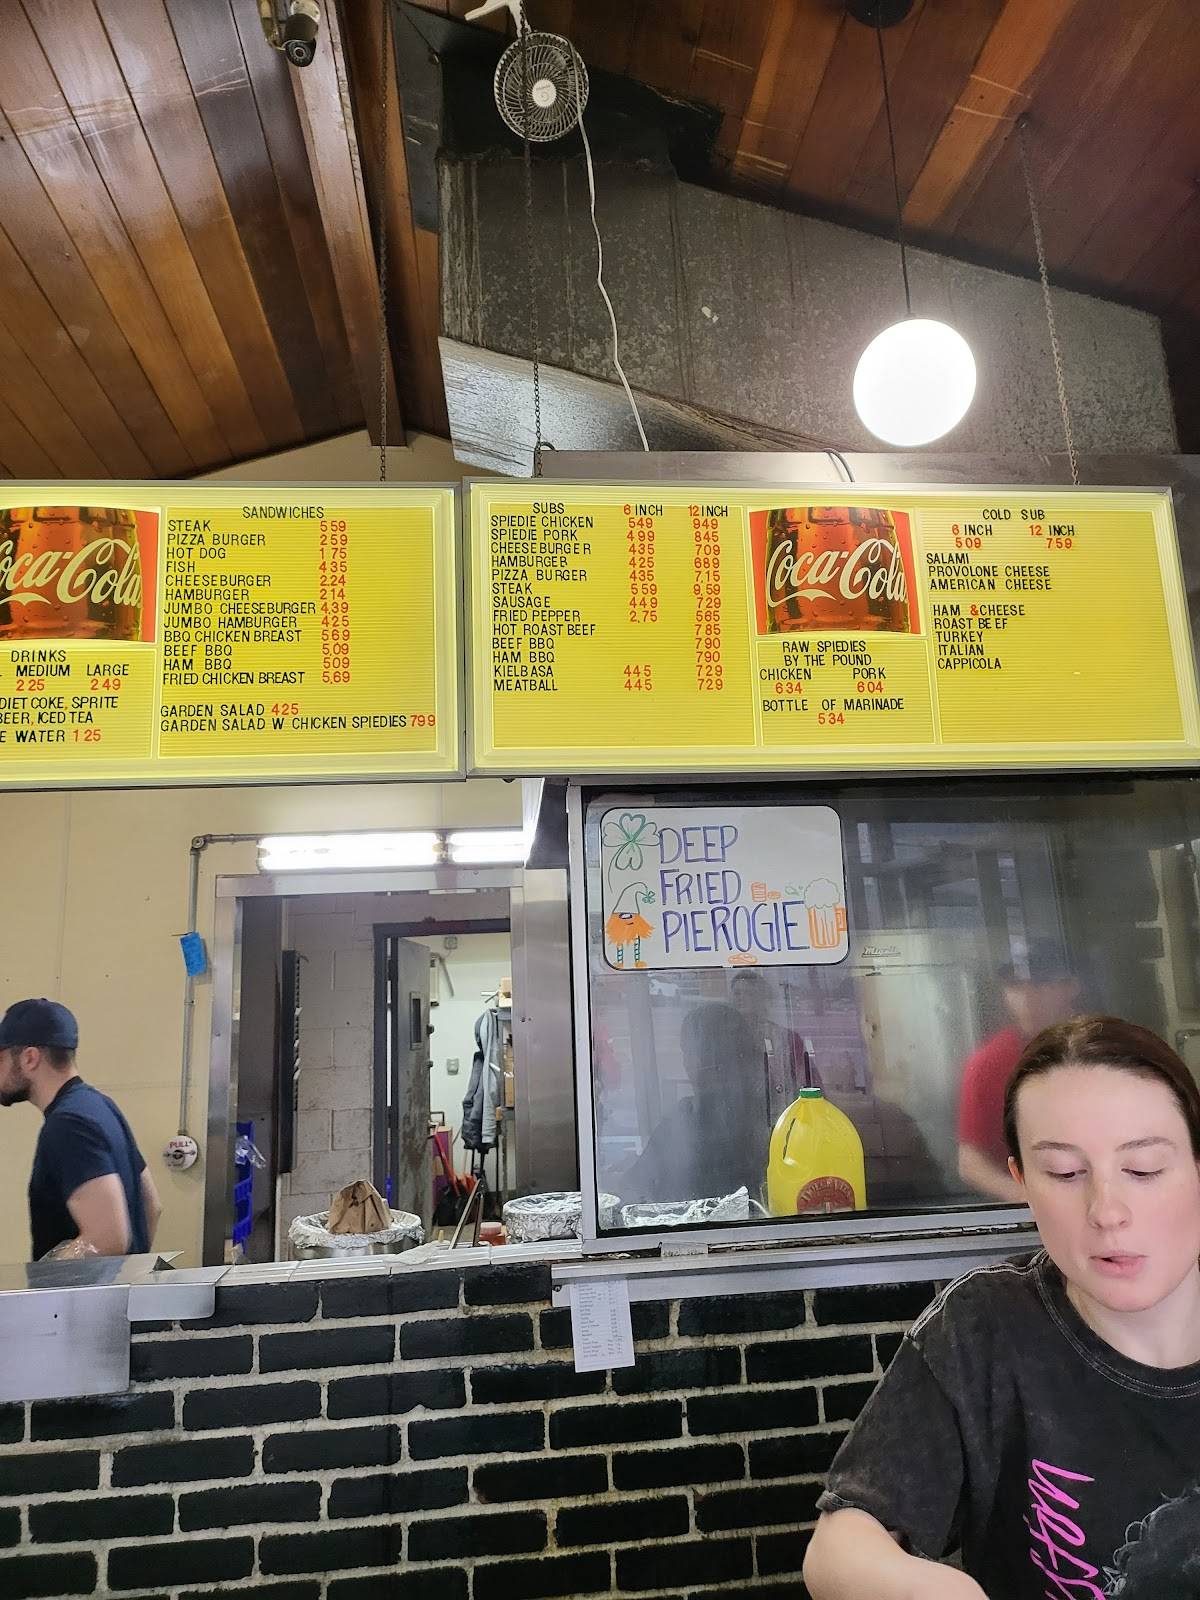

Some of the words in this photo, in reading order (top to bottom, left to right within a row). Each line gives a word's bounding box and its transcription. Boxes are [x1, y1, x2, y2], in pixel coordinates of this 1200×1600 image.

[243, 506, 324, 519] SANDWICHES
[533, 502, 564, 515] SUBS
[624, 504, 631, 516] 6
[635, 504, 663, 517] INCH
[688, 505, 699, 517] 12
[701, 505, 728, 518] INCH
[982, 508, 1011, 521] COLD
[1021, 509, 1045, 520] SUB
[168, 520, 211, 532] STEAK
[491, 515, 536, 528] SPIEDIE
[542, 516, 593, 529] CHICKEN
[491, 528, 537, 541] SPIEDIE
[544, 529, 577, 541] PORK
[951, 524, 959, 536] 6
[964, 524, 993, 536] INCH
[1029, 524, 1042, 536] 12
[1049, 524, 1075, 537] INCH
[167, 534, 205, 546] PIZZA
[212, 534, 265, 546] BURGER
[166, 548, 192, 559] HOT
[200, 548, 226, 559] DOG
[491, 542, 591, 555] CHEESEBURGER
[926, 553, 969, 564] SALAMI
[0, 538, 142, 608] oca-Cola
[166, 561, 195, 573] FISH
[766, 537, 909, 608] Coca-Cola
[928, 566, 998, 577] PROVOLONE
[1005, 566, 1050, 577] CHEESE
[166, 574, 271, 587] CHEESEBURGER
[492, 569, 528, 581] PIZZA
[537, 569, 587, 582] BURGER
[492, 582, 532, 595] STEAK
[930, 578, 995, 590] AMERICAN
[1005, 578, 1052, 590] CHEESE
[165, 589, 249, 601] HAMBURGER
[164, 602, 212, 615] JUMBO
[220, 602, 316, 614] CHEESEBURGER
[493, 596, 550, 608] SAUSAGE
[494, 610, 527, 622] FRIED
[532, 610, 581, 622] PEPPER
[933, 604, 960, 617] HAM
[163, 616, 211, 629] JUMBO
[218, 616, 297, 628] HAMBURGER
[934, 617, 973, 629] ROAST
[978, 617, 1007, 629] BEEF
[164, 630, 190, 643] BBQ
[195, 630, 250, 643] CHICKEN
[254, 630, 302, 642] BREAST
[493, 624, 516, 636] HOT
[523, 624, 565, 635] ROAST
[568, 624, 596, 636] BEEF
[493, 637, 522, 650] BEEF
[529, 638, 555, 650] BBQ
[936, 631, 983, 643] TURKEY
[164, 645, 197, 657] BEEF
[205, 644, 232, 657] BBQ
[782, 641, 809, 653] RAW
[817, 640, 866, 653] SPIEDIES
[939, 644, 984, 656] ITALIAN
[11, 650, 66, 663] DRINKS
[493, 651, 521, 663] HAM
[529, 651, 555, 664] BBQ
[784, 654, 801, 667] BY
[804, 654, 825, 667] THE
[832, 654, 872, 666] POUND
[937, 657, 1002, 669] CAPPICOLA
[16, 664, 70, 677] MEDIUM
[87, 664, 129, 676] LARGE
[164, 659, 193, 671] HAM
[205, 658, 231, 670] BBQ
[494, 665, 553, 677] KIELBASA
[163, 673, 198, 685] FRIED
[202, 672, 254, 685] CHICKEN
[259, 672, 305, 684] BREAST
[760, 668, 811, 681] CHICKEN
[852, 667, 886, 680] PORK
[494, 679, 558, 691] MEATBALL
[0, 697, 27, 710] DIET
[72, 696, 118, 709] SPRITE
[762, 699, 808, 712] BOTTLE
[822, 698, 836, 711] OF
[844, 698, 904, 711] MARINADE
[38, 712, 65, 724] ICED
[70, 711, 93, 723] TEA
[160, 704, 213, 718] GARDEN
[220, 704, 264, 717] SALAD
[160, 719, 216, 732] GARDEN
[222, 718, 265, 731] SALAD
[273, 718, 284, 730] W
[292, 717, 346, 729] CHICKEN
[352, 715, 406, 728] SPIEDIES
[16, 730, 65, 743] WATER
[658, 825, 738, 864] DEEP
[660, 868, 742, 905] FRIED
[662, 900, 810, 953] PIEROGIE
